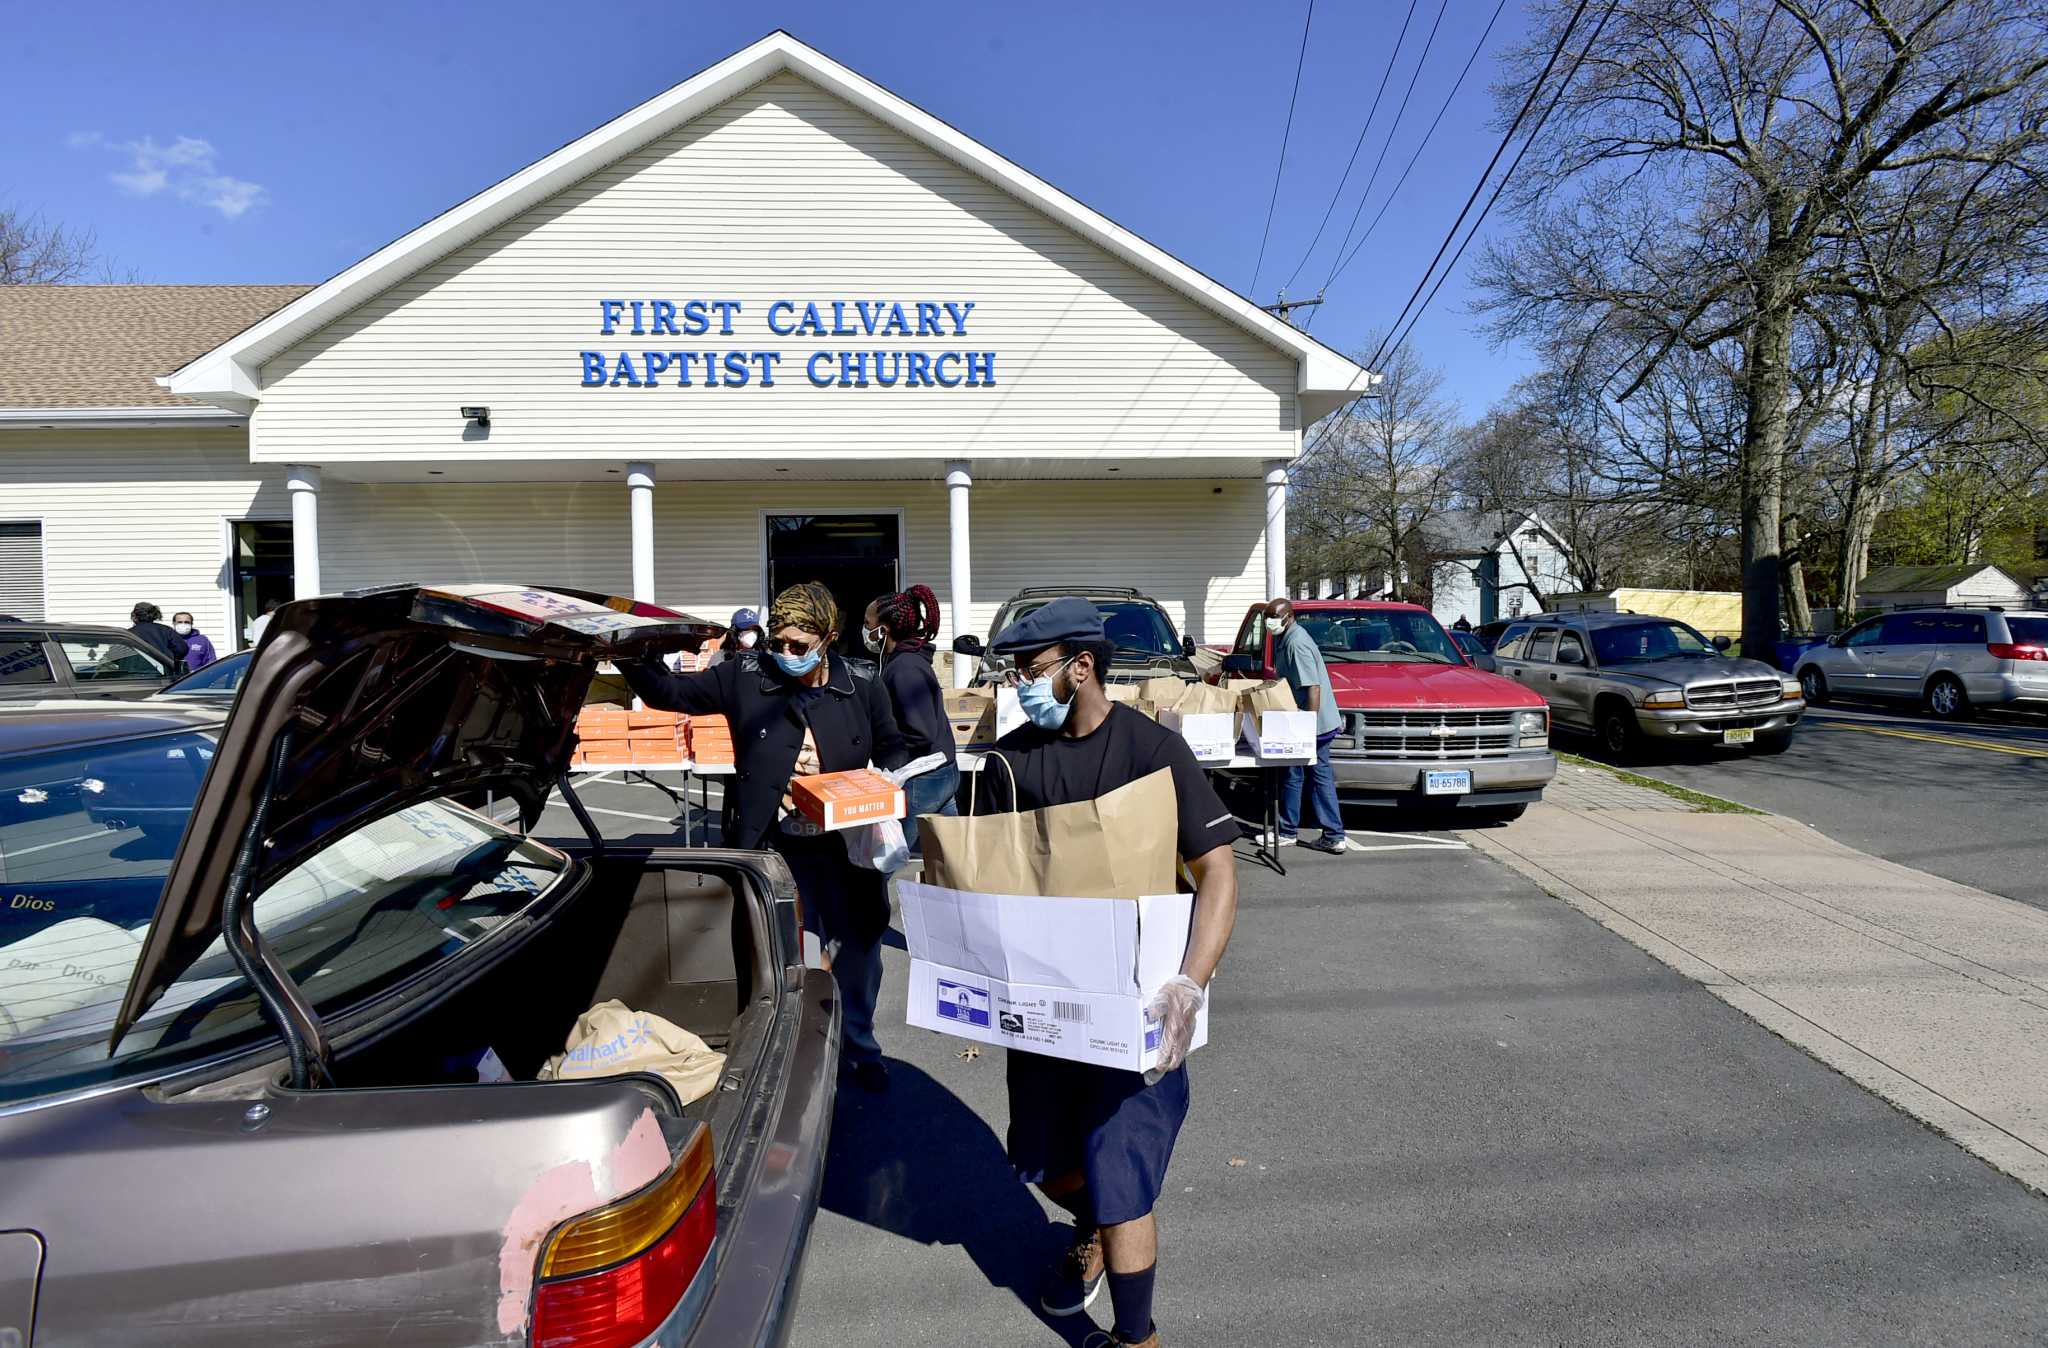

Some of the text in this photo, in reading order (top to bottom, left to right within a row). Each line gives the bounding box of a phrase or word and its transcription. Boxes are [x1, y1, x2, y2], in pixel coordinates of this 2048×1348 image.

[599, 299, 976, 337] FIRST CALVARY
[580, 351, 997, 388] BAPTIST CHURCH
[844, 801, 885, 816] YOU MATTER
[10, 894, 56, 912] Dios
